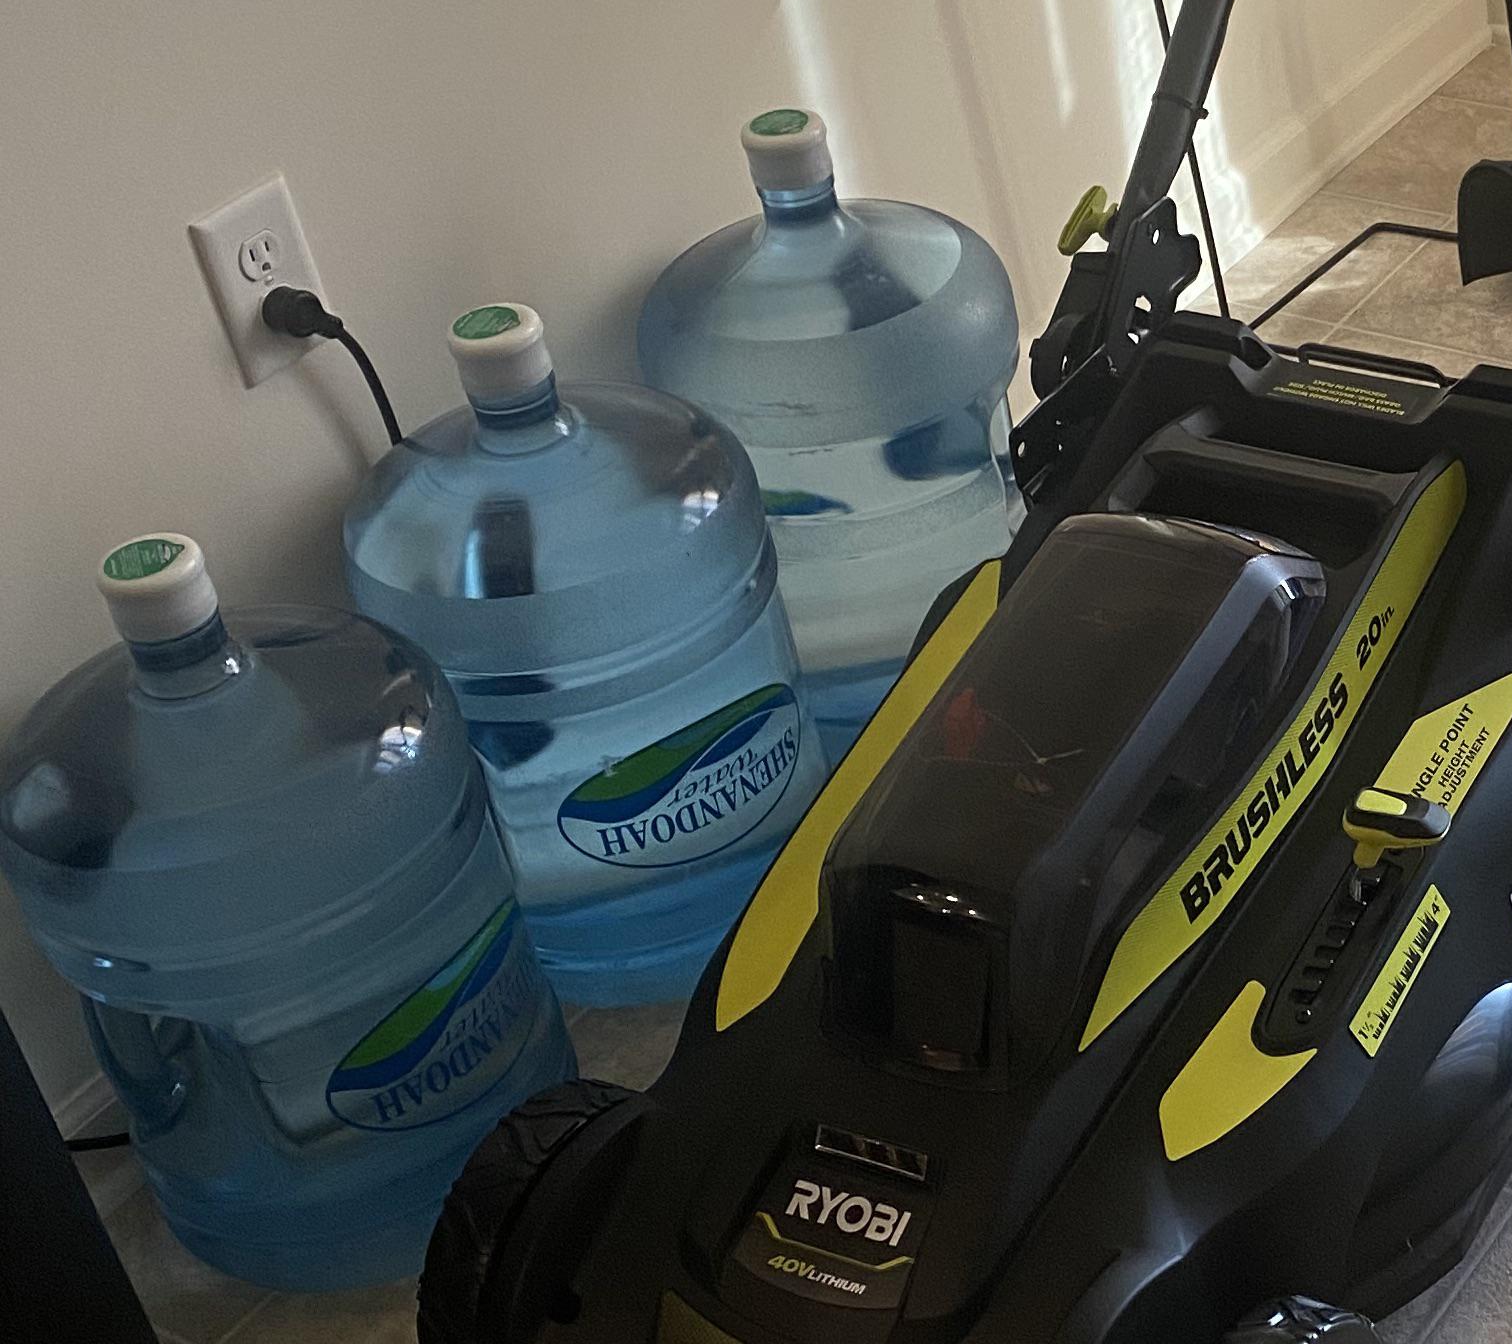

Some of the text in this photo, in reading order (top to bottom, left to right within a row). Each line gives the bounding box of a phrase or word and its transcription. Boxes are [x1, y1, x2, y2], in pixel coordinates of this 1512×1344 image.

[596, 725, 797, 857] SHENANDOAH
[666, 747, 759, 808] Water
[1411, 703, 1474, 798] NGLE POINT
[1438, 739, 1470, 788] HEIGHT
[1438, 726, 1490, 809] ADJUSTMENT
[1180, 672, 1348, 925] BRUSHLESS
[785, 1179, 912, 1247] RYOBI
